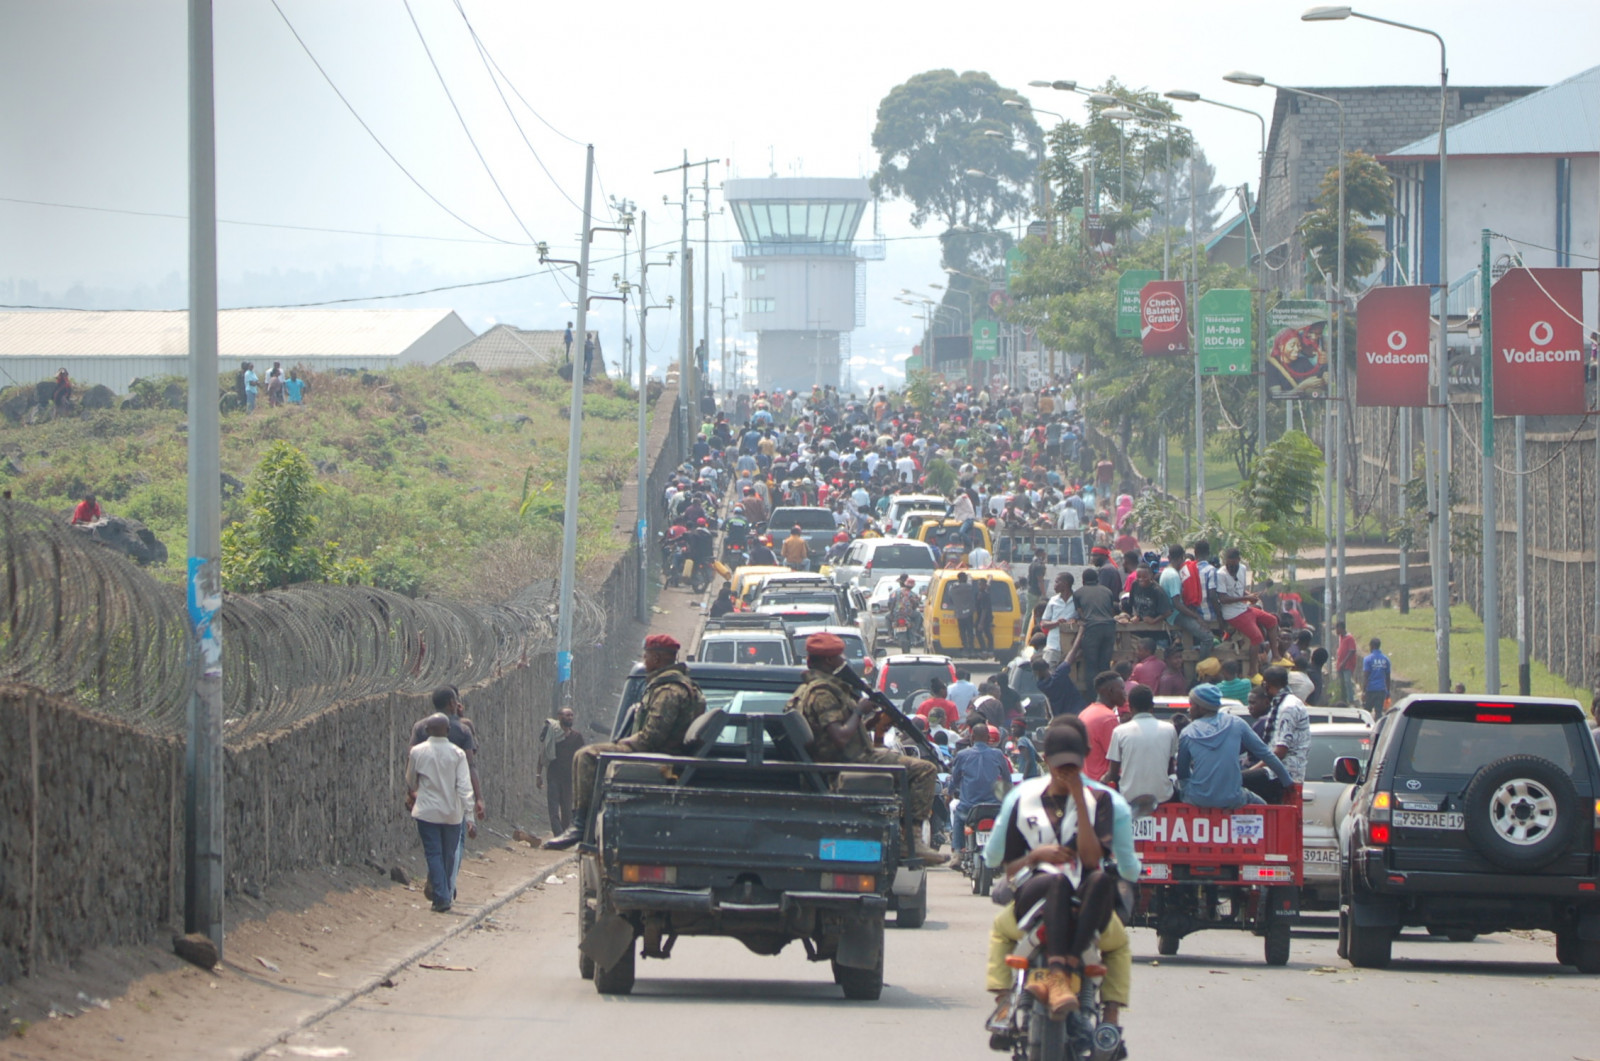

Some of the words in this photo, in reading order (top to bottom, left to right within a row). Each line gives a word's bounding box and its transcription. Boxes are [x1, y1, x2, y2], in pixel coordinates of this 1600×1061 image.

[1149, 298, 1176, 307] Check
[1146, 307, 1180, 315] Balance
[1148, 314, 1179, 323] Gratuit
[1206, 325, 1241, 334] M-Pesa
[1204, 337, 1224, 345] RDC
[1226, 337, 1245, 347] App
[1366, 352, 1428, 364] Vodacom
[1503, 348, 1581, 364] Vodacom
[1449, 814, 1464, 828] 19
[1236, 825, 1260, 835] 927
